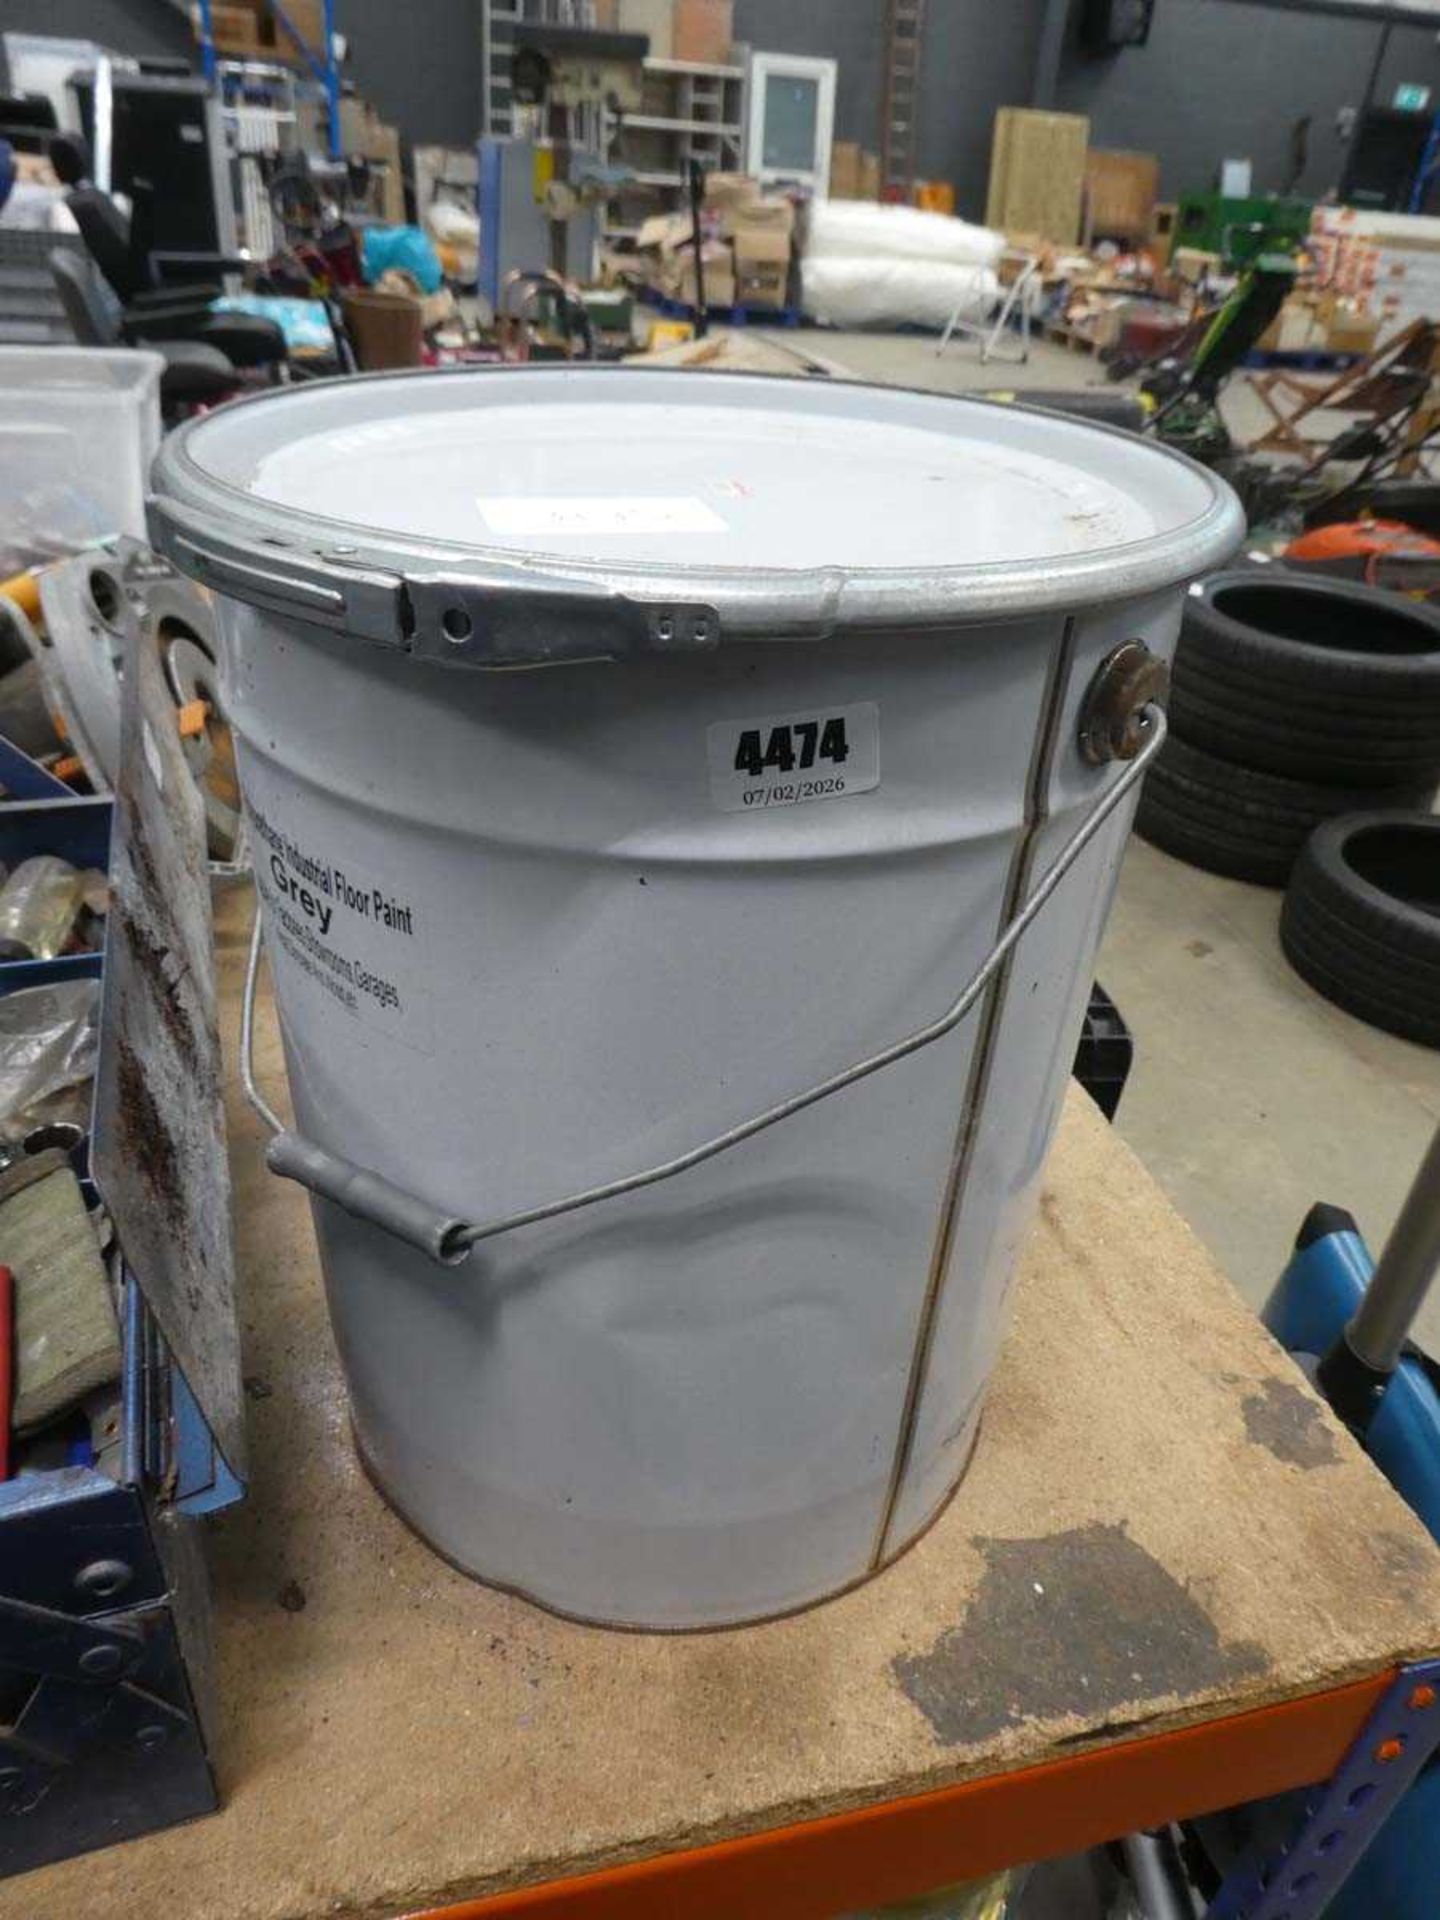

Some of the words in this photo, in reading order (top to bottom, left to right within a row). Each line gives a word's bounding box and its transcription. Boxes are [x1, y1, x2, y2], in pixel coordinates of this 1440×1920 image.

[735, 717, 849, 776] 4474
[743, 775, 845, 805] 07/02/2026
[270, 855, 332, 935] Grey
[334, 869, 369, 917] Floor
[373, 889, 413, 936] Paint
